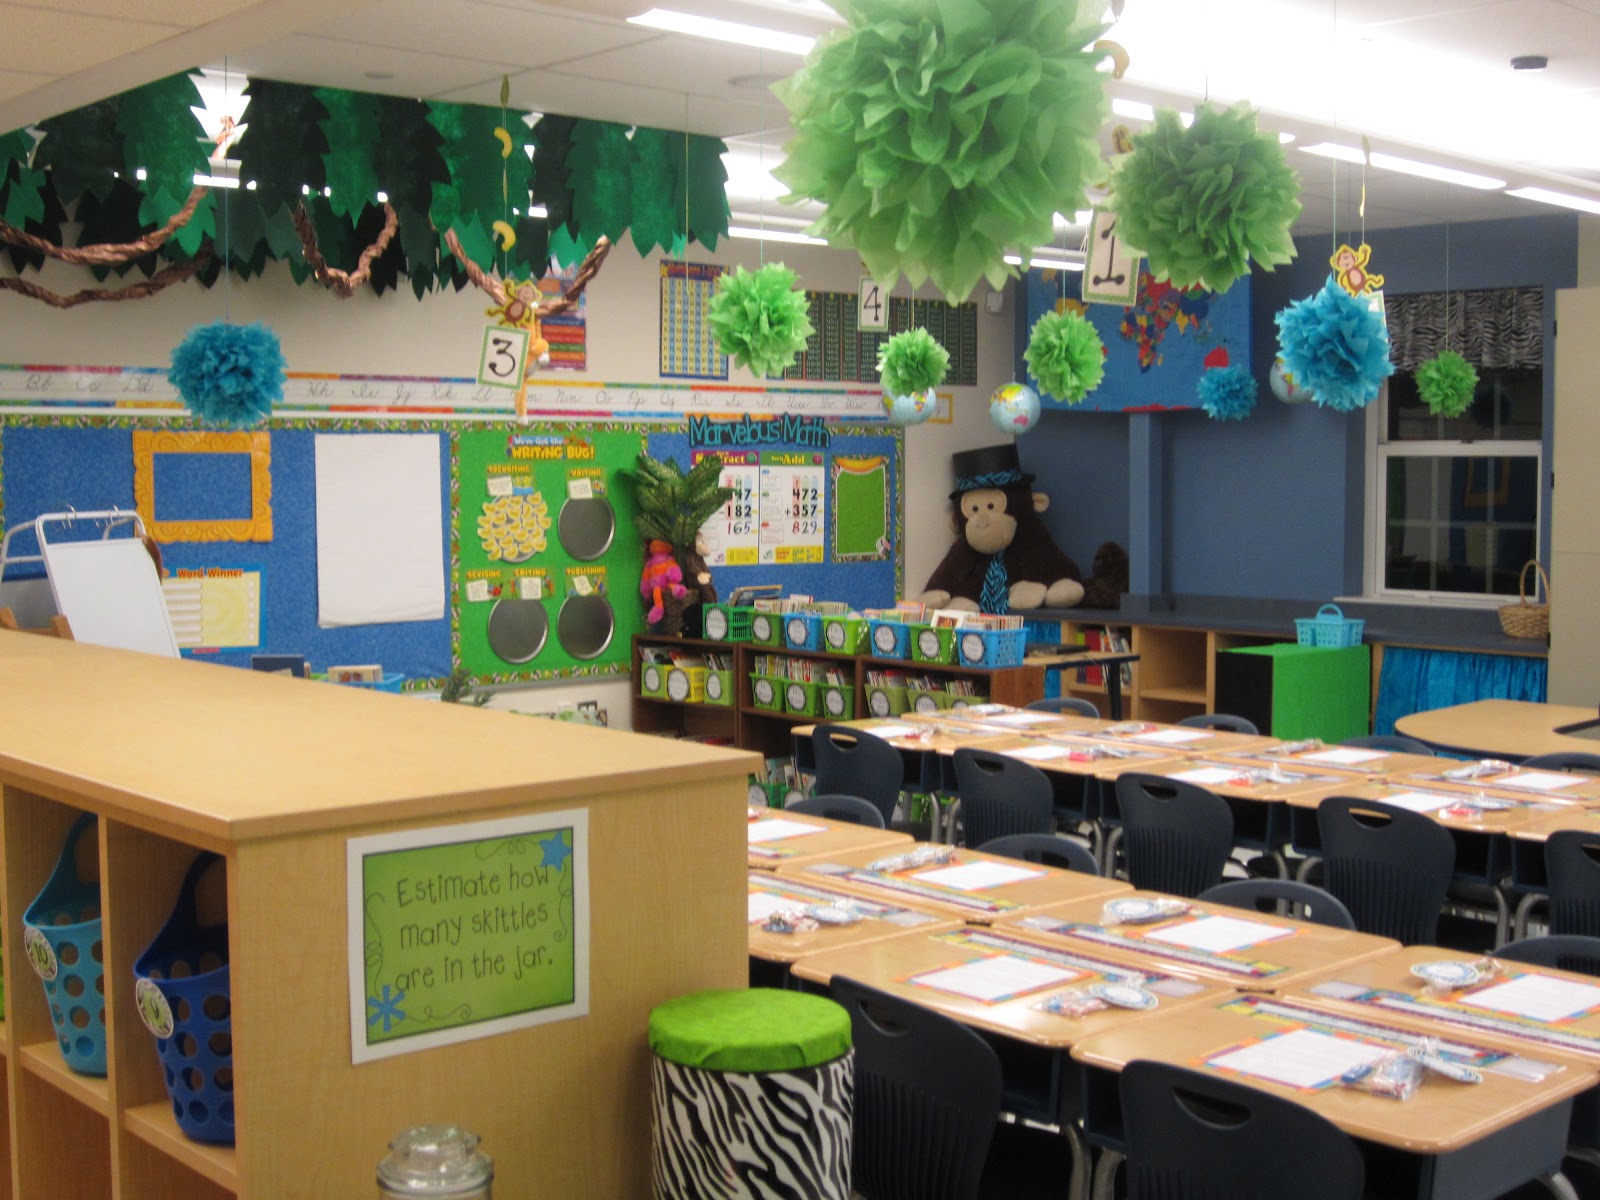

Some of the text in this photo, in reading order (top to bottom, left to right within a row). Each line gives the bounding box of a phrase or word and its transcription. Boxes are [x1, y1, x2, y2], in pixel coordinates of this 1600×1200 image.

[863, 285, 881, 322] 4
[488, 338, 516, 377] 3
[690, 413, 831, 448] Marvelous Math
[566, 445, 595, 459] BUG!
[782, 454, 806, 465] Add
[792, 488, 818, 501] 472
[726, 521, 752, 536] 165
[792, 520, 818, 536] 829
[177, 567, 204, 578] Word
[207, 567, 244, 578] Winner
[567, 566, 606, 575] PUBLISHING
[396, 863, 549, 908] Estimate how
[400, 901, 548, 949] many skittles
[33, 942, 49, 965] 10
[395, 945, 553, 993] are in the jar.
